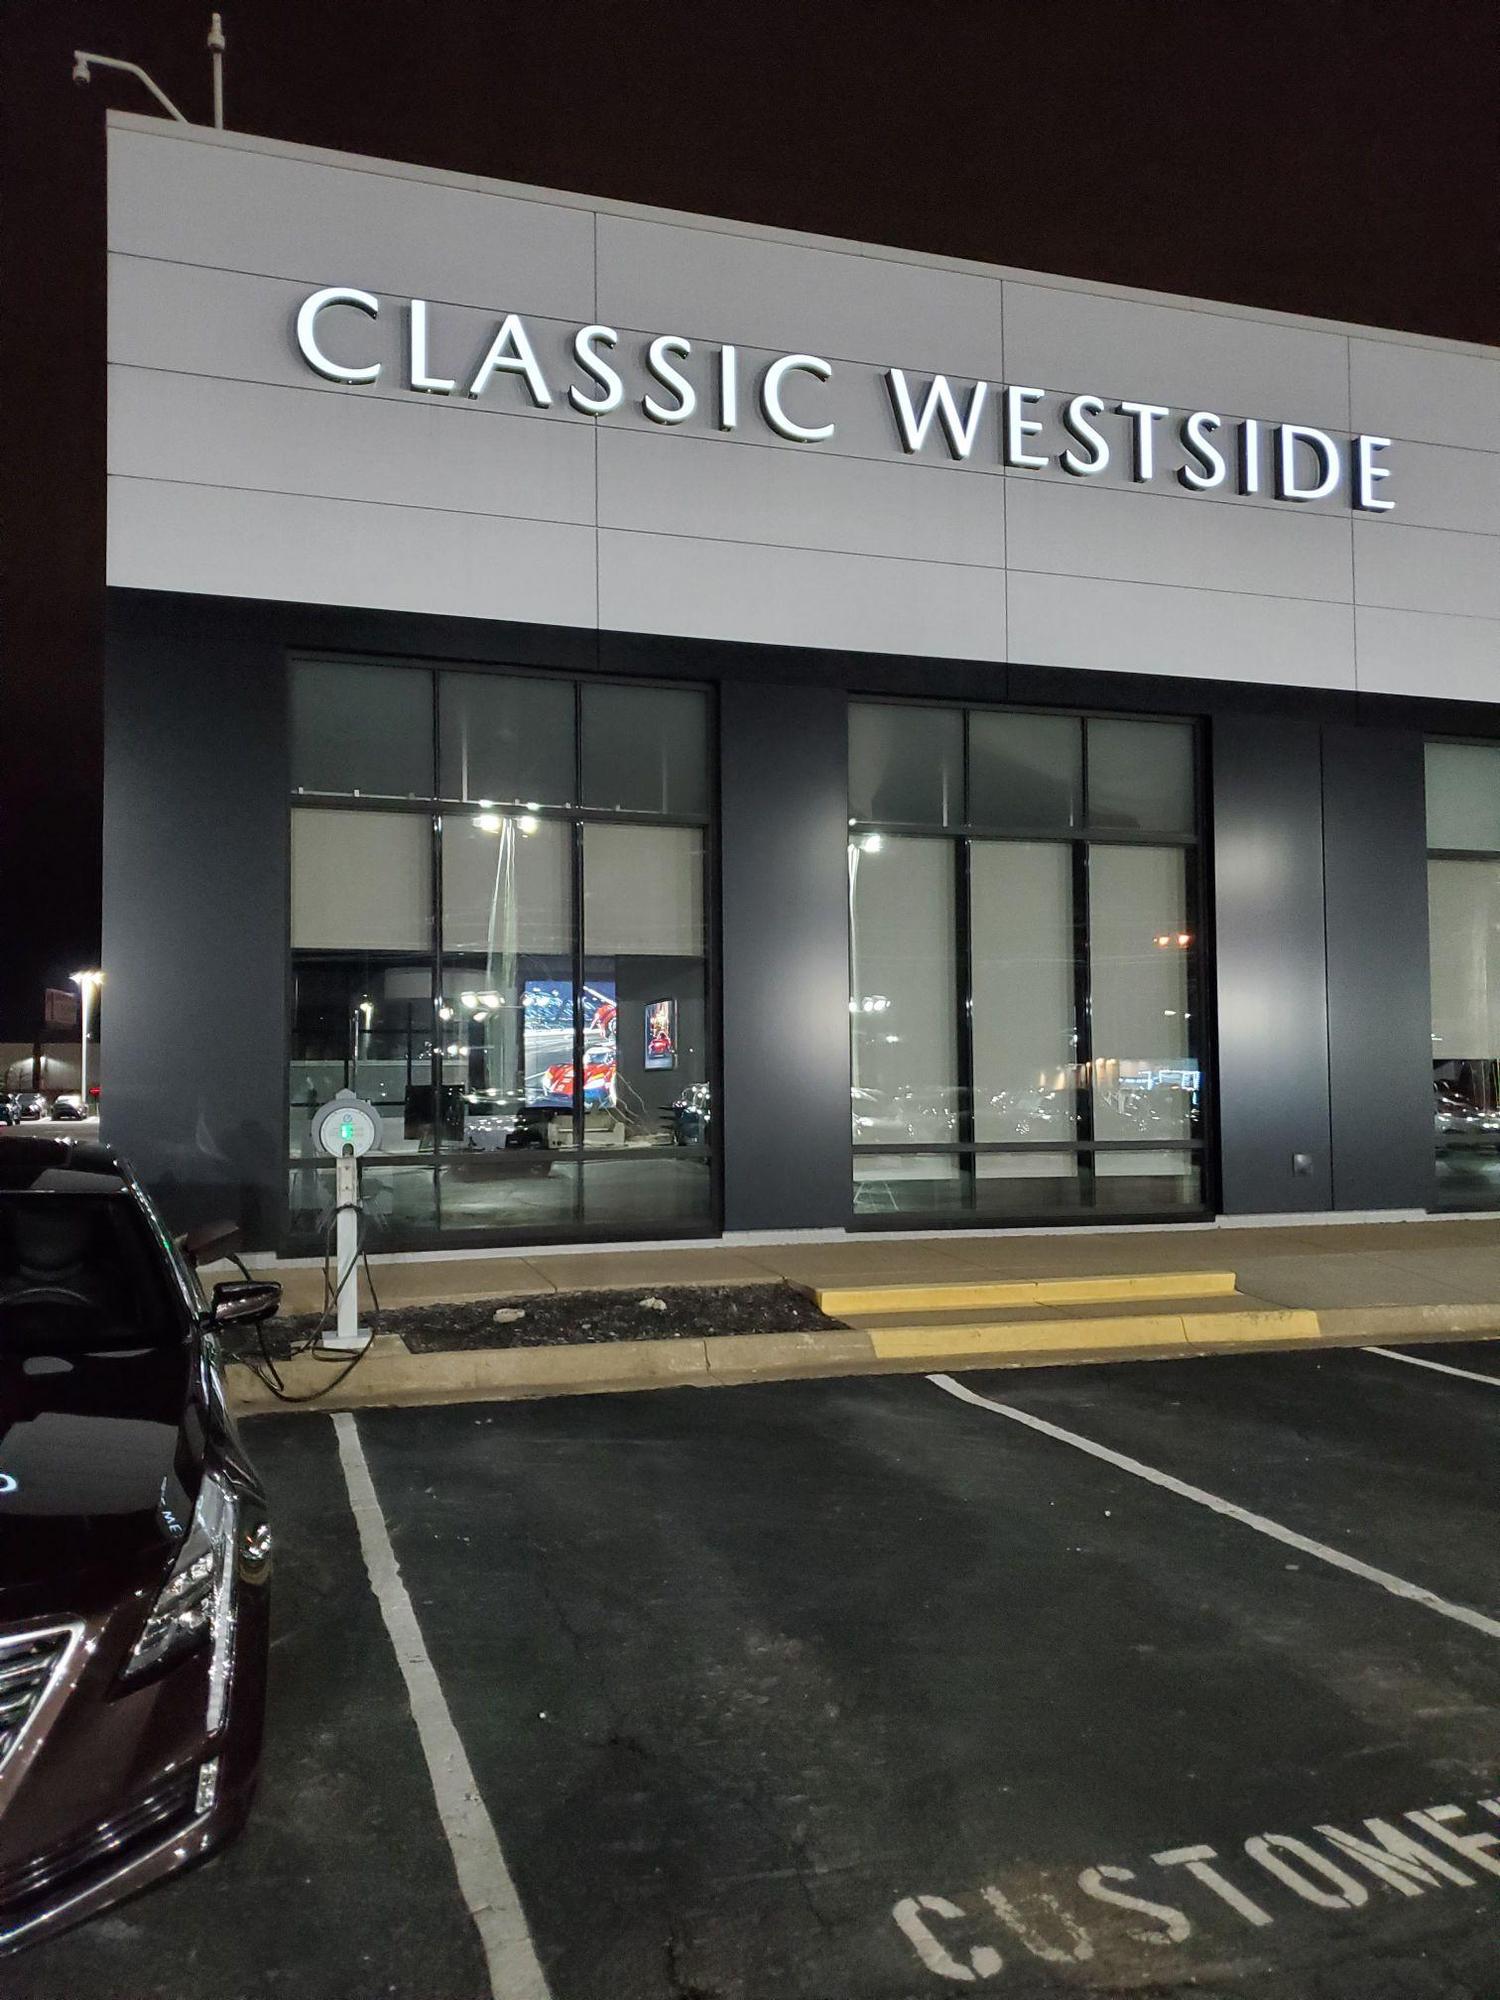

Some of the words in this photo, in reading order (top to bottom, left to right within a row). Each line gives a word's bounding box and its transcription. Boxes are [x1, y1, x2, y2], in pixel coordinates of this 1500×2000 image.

[296, 287, 836, 444] CLASSIC
[885, 368, 1396, 512] WESTSIDE
[893, 1797, 1500, 1981] CUSTOME
